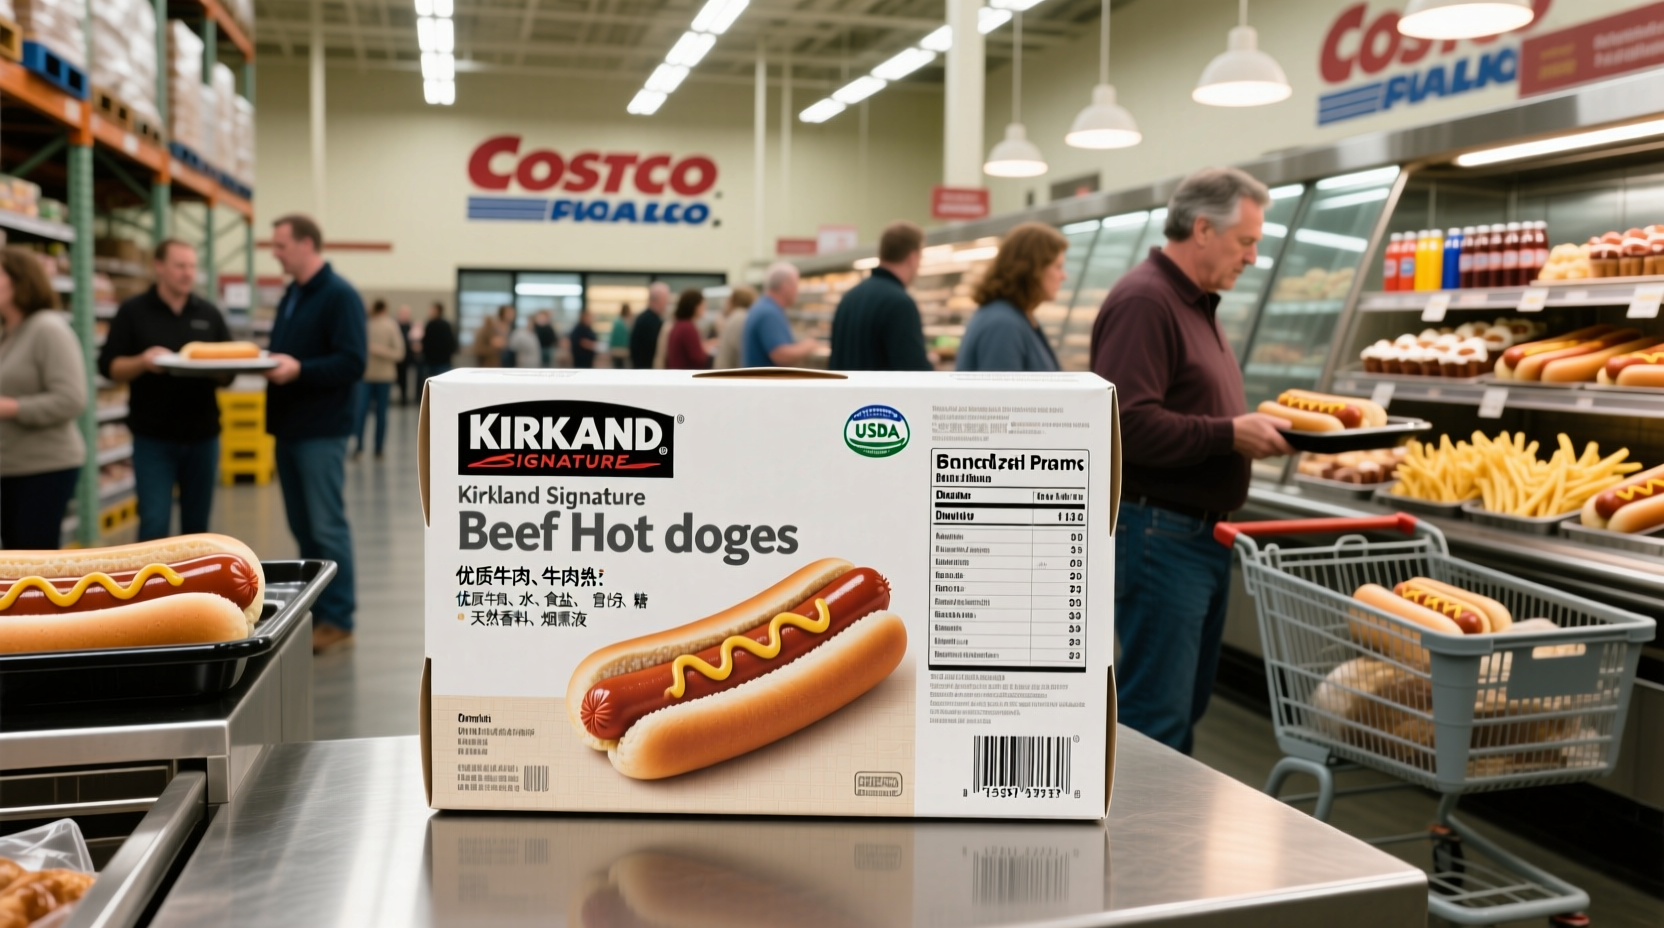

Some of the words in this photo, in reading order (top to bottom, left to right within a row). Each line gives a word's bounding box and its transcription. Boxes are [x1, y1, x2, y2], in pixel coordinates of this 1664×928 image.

[468, 133, 718, 197] COSTCO
[470, 413, 663, 451] KIRKAND
[855, 423, 900, 439] USDA
[468, 453, 661, 469] SIGNATURE
[458, 485, 540, 504] Kirkland
[547, 486, 646, 509] Signature
[459, 510, 561, 551] Beef
[572, 512, 654, 553] Hot
[665, 512, 799, 566] doges
